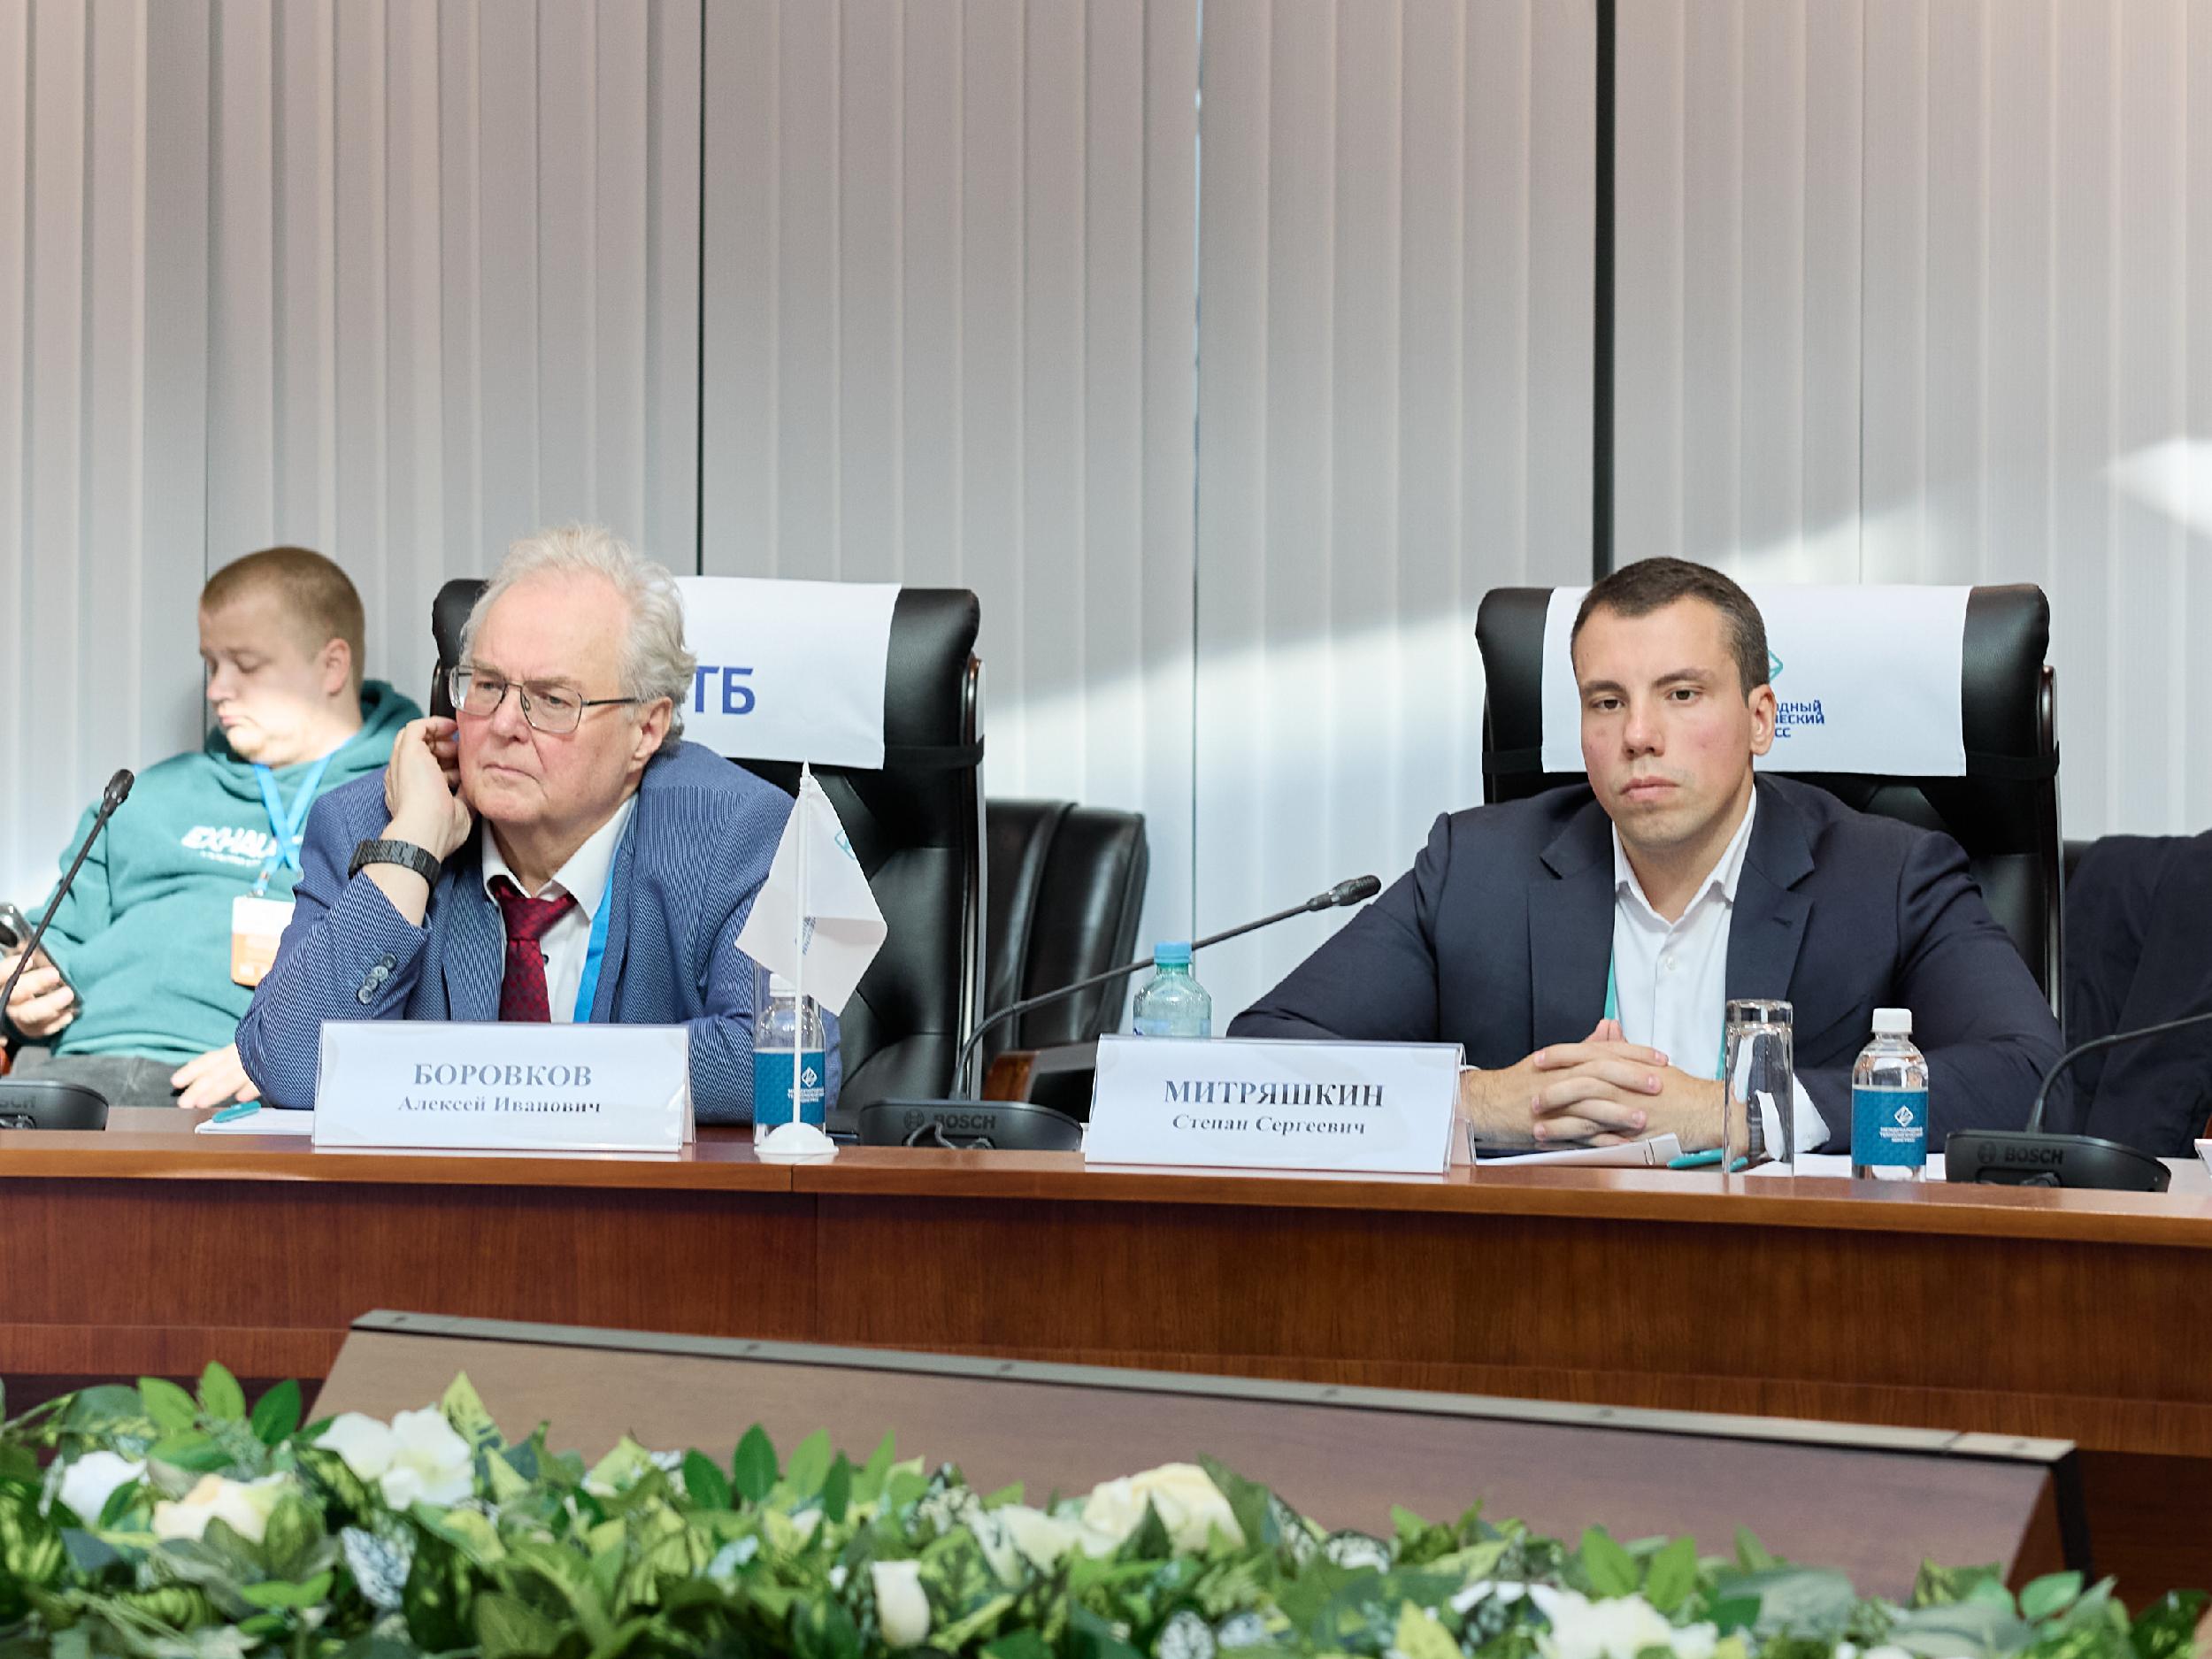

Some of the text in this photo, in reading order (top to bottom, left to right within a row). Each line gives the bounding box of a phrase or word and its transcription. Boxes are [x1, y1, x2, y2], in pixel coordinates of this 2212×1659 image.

[1777, 699, 1822, 713] ДНЫЙ
[413, 1063, 592, 1087] БОРОВКОВ
[1164, 1079, 1386, 1108] МИТРЯШКИН
[398, 1095, 601, 1113] Алексей Иванович
[933, 1113, 996, 1130] BOSCH
[1172, 1113, 1365, 1136] Степан Сергеевич
[2004, 1148, 2064, 1165] BOSCH
